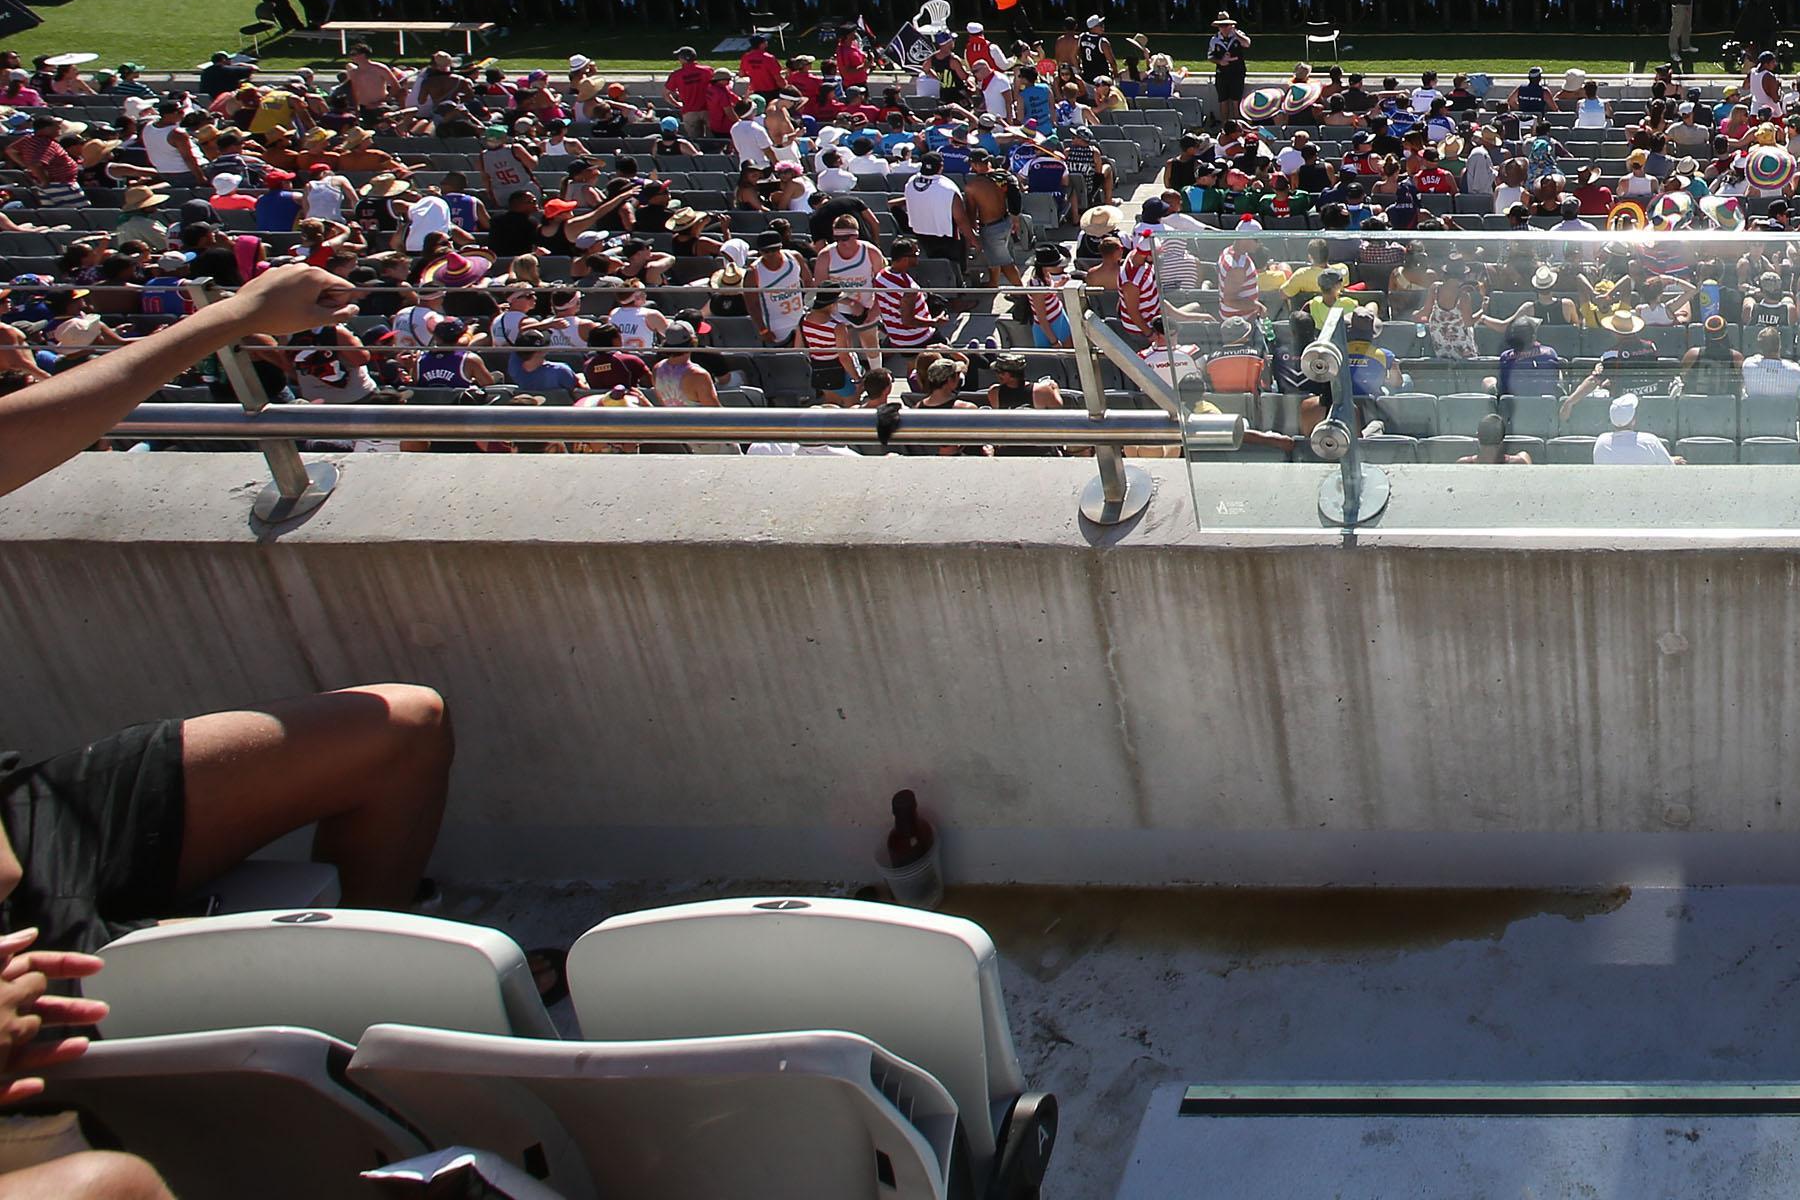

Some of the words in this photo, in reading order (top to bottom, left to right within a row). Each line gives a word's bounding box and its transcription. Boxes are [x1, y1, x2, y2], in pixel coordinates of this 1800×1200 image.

[1085, 48, 1093, 62] 8
[495, 167, 520, 186] 95
[1421, 176, 1441, 187] BOSH
[780, 297, 802, 315] 33
[1757, 313, 1779, 324] ALLEN
[1223, 347, 1258, 357] HYUNDAI
